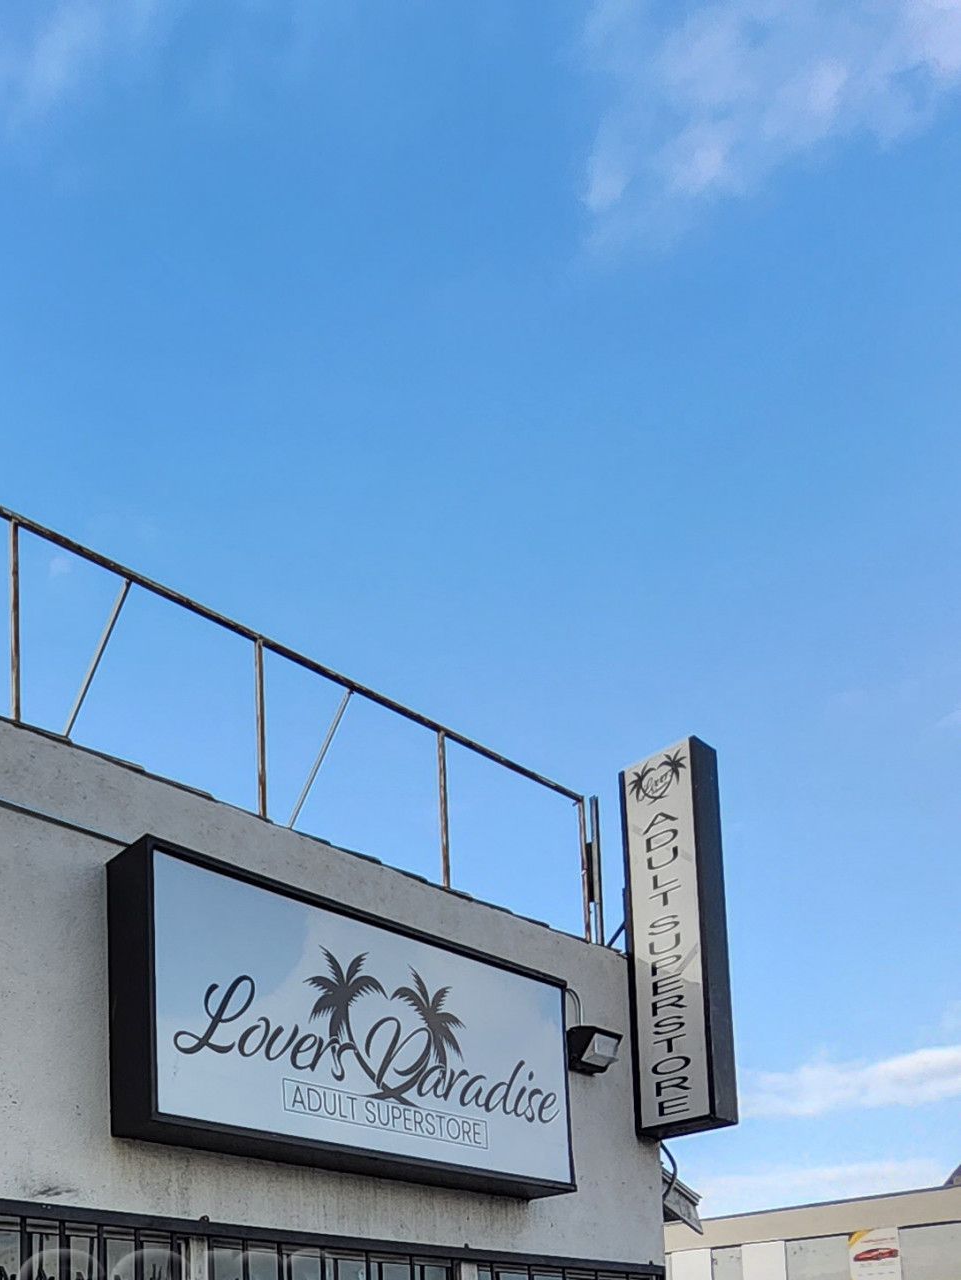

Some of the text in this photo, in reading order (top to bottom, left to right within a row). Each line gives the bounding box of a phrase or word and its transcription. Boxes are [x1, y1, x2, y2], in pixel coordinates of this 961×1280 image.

[643, 812, 691, 1118] ADULT SUPERSTORE
[173, 974, 559, 1124] Lovers Paradise
[292, 1085, 483, 1146] ADULT SUPERSTORE
